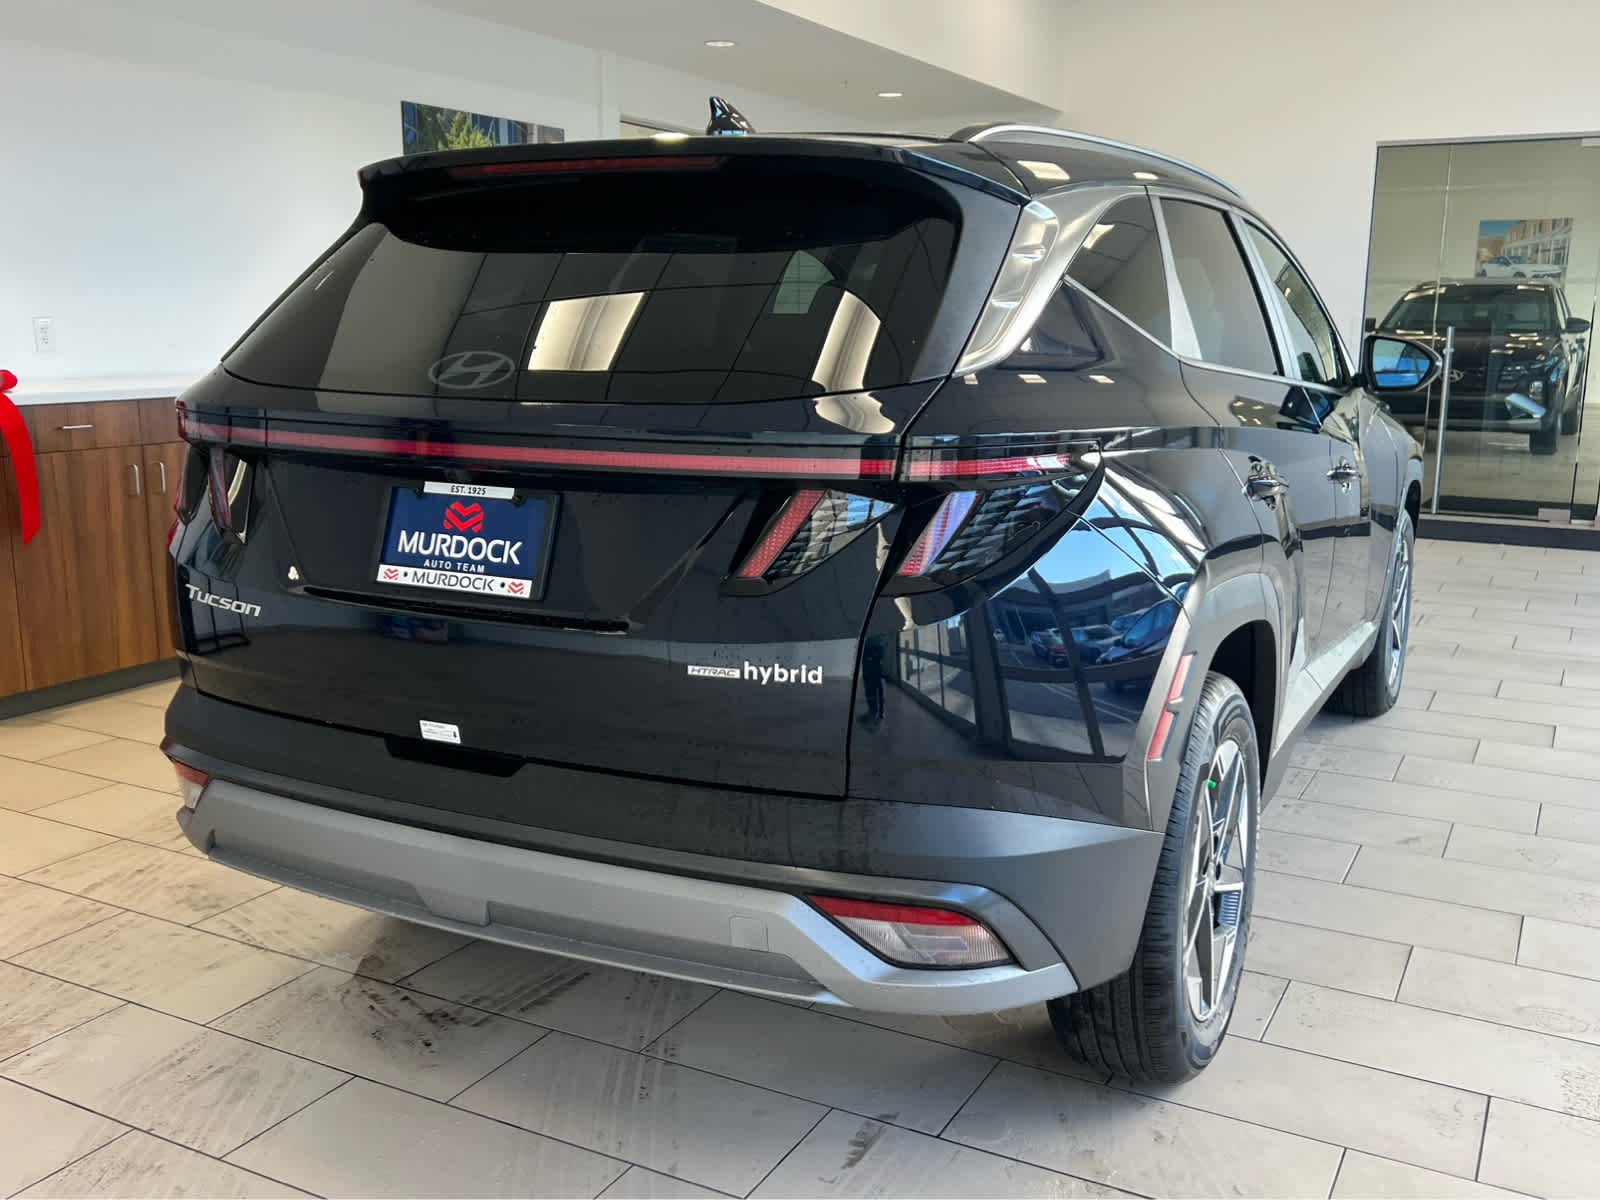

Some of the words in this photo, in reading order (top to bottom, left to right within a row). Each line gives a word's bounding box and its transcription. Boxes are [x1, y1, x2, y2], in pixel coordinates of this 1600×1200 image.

[450, 485, 466, 494] EST.
[468, 486, 487, 496] 1925
[397, 530, 523, 565] MURDOCK
[423, 559, 452, 570] AUTO
[456, 562, 485, 573] TEAM
[411, 571, 495, 592] MURDOCK
[743, 660, 823, 685] hybrid
